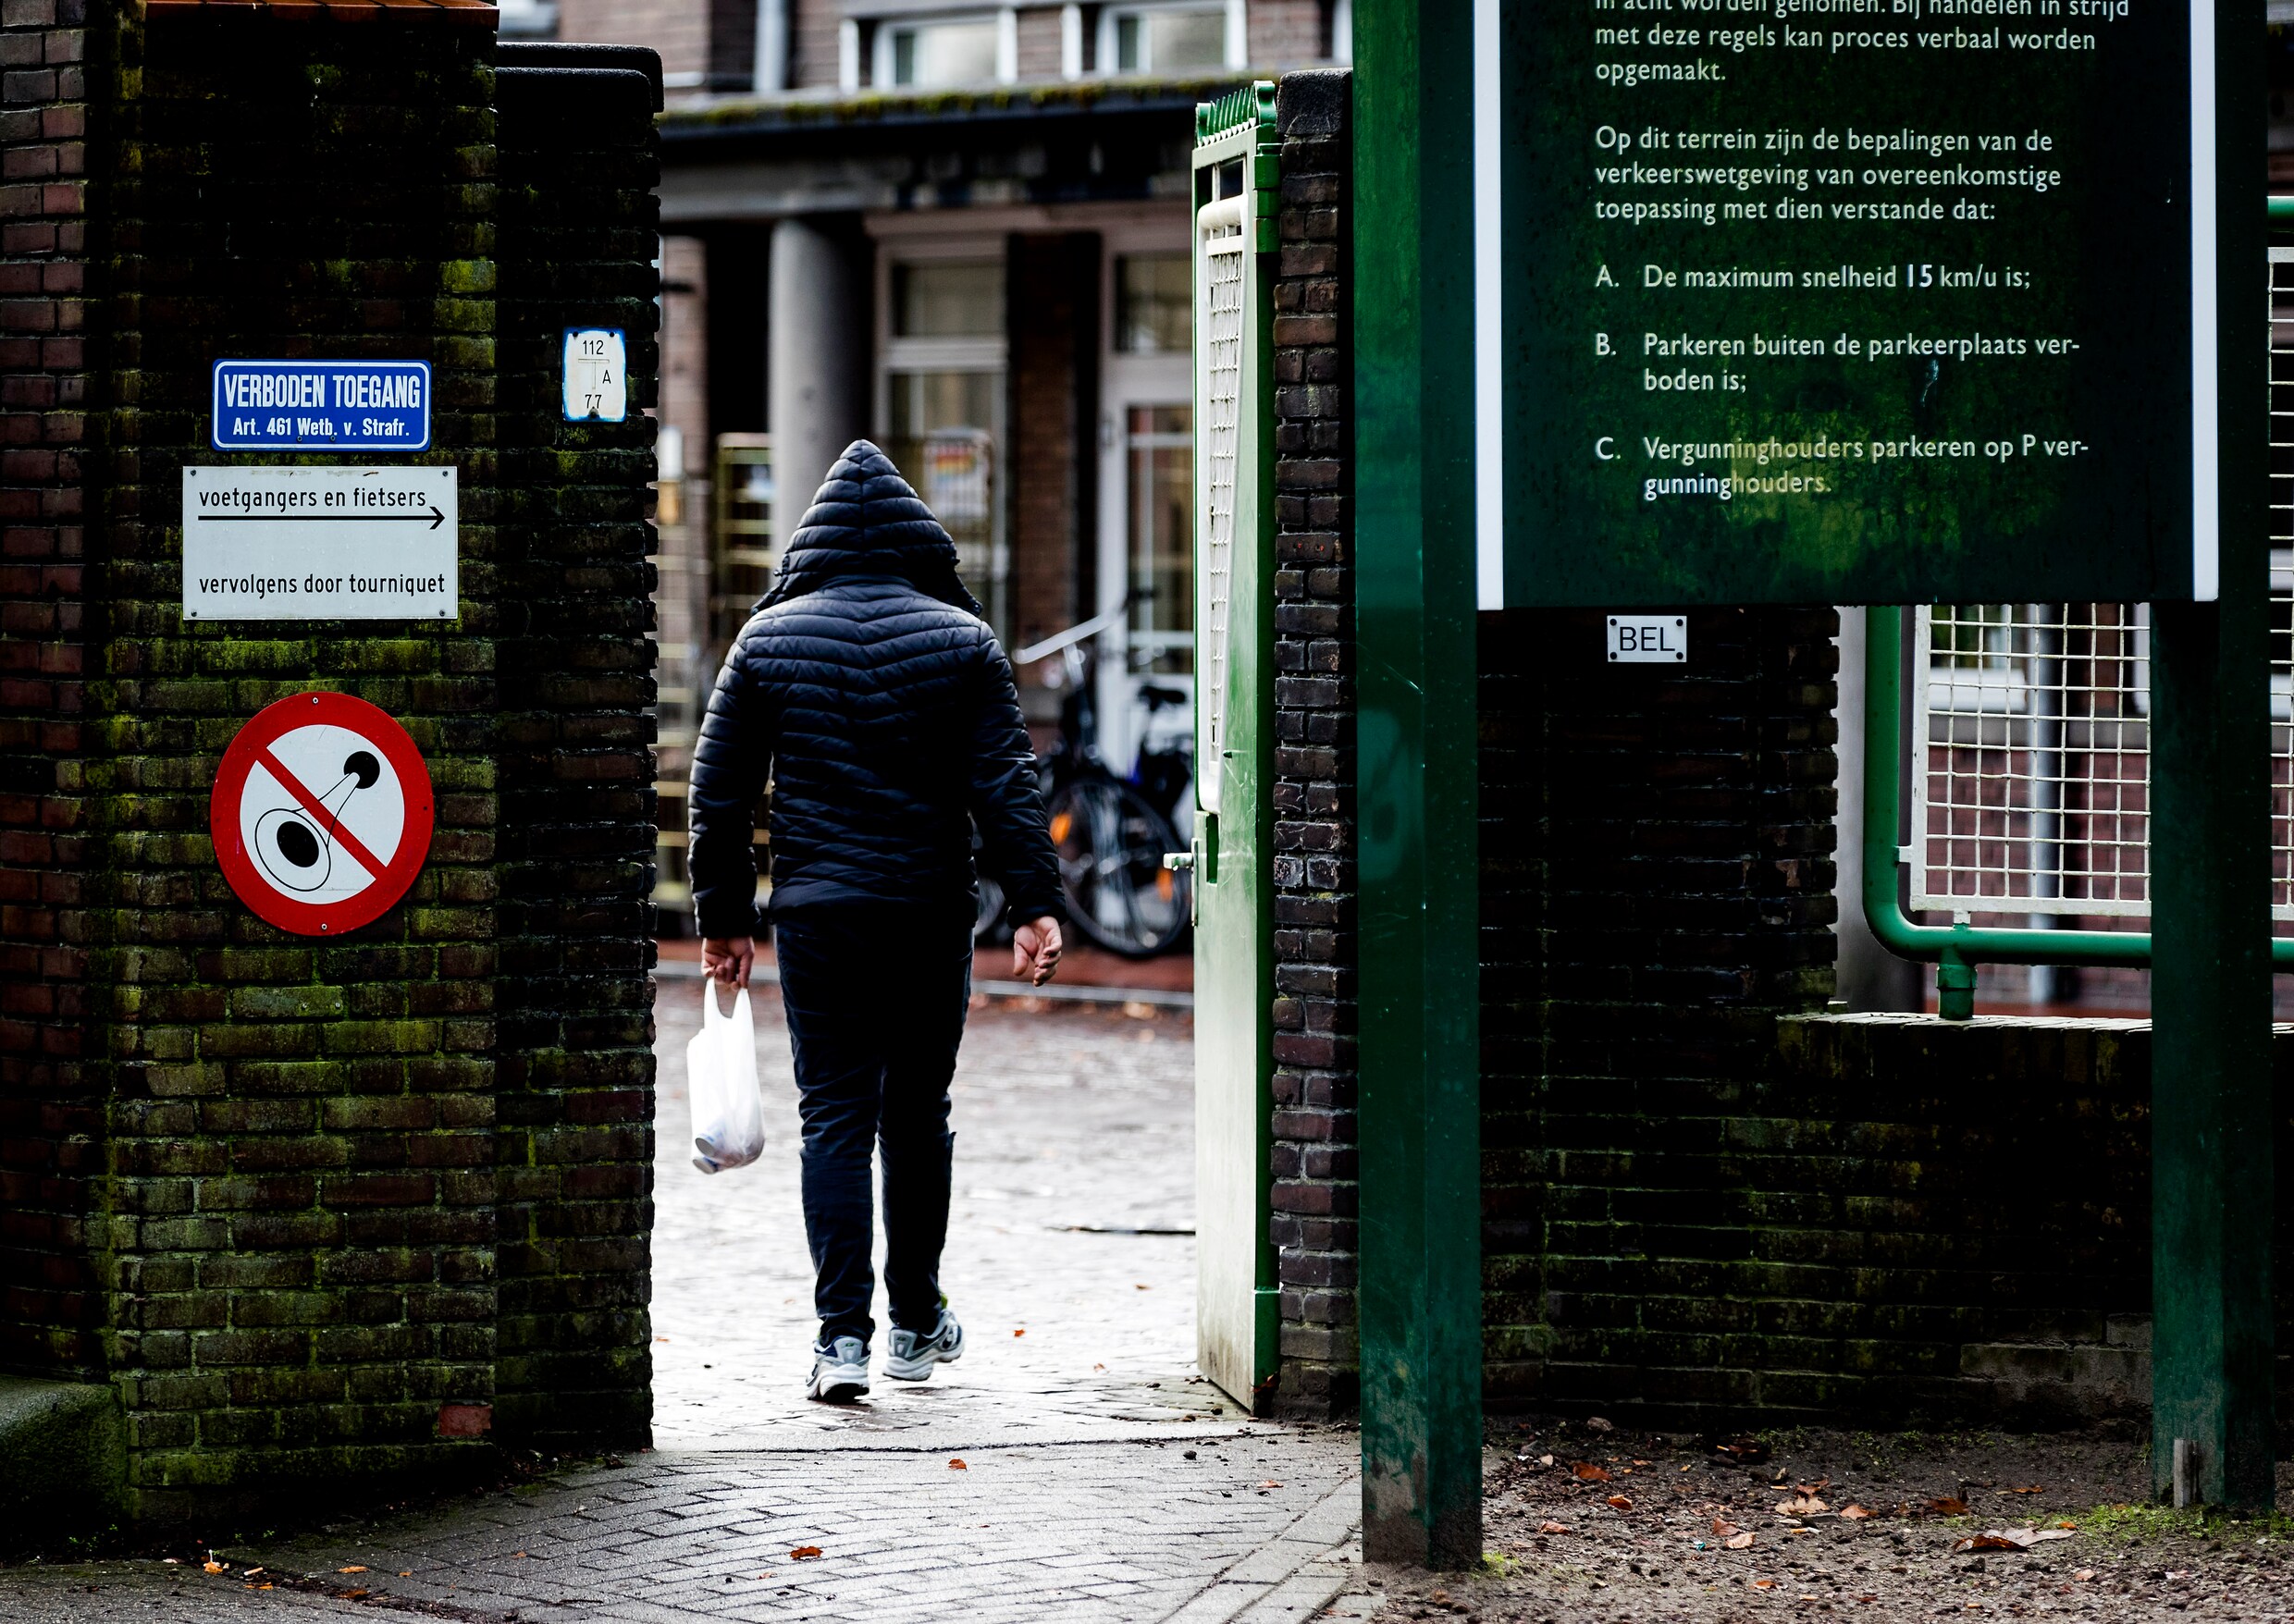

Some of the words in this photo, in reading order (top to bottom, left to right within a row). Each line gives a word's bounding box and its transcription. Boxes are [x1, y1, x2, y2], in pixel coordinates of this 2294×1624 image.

[1775, 0, 1886, 18] genomen.
[1596, 27, 1640, 45] met
[1647, 22, 1700, 46] deze
[1709, 23, 1776, 53] regels
[1784, 23, 1823, 47] kan
[1832, 30, 1909, 54] proces
[1917, 26, 1999, 49] verbaal
[2007, 27, 2095, 50] worden
[1596, 58, 1726, 87] opgemaakt.
[1595, 125, 1632, 154] Op
[1639, 126, 1671, 149] dit
[1677, 128, 1757, 150] terrein
[1764, 128, 1804, 156] zijn
[1812, 127, 1840, 150] de
[1848, 127, 1969, 157] bepalingen
[1978, 135, 2016, 151] van
[2026, 129, 2053, 152] de
[1595, 162, 1809, 191] verkeerswetgeving
[1816, 168, 1854, 185] van
[1862, 164, 2061, 192] overeenkomstige
[1595, 197, 1717, 226] toepassing
[1723, 201, 1769, 219] met
[1775, 196, 1823, 219] dien
[1831, 197, 1944, 220] verstande
[1952, 197, 1995, 220] dat:
[1595, 265, 1620, 288] A.
[1644, 265, 1677, 288] De
[1684, 265, 1794, 288] maximum
[1802, 265, 1897, 288] snelheid
[1907, 264, 1933, 288] 15
[1940, 263, 1997, 288] km/u
[2005, 265, 2030, 289] is;
[583, 339, 604, 355] 112
[1595, 332, 1617, 356] B.
[1644, 332, 1745, 356] Parkeren
[1753, 332, 1825, 356] buiten
[1832, 332, 1861, 355] de
[1868, 332, 2027, 362] parkeerplaats
[2034, 338, 2080, 355] ver-
[602, 369, 611, 385] A
[1644, 367, 1714, 391] boden
[1721, 368, 1746, 393] is;
[224, 374, 326, 408] VERBODEN
[332, 374, 422, 409] TOEGANG
[232, 417, 261, 436] Art.
[266, 417, 291, 436] 461
[297, 417, 338, 437] Wetb.
[343, 422, 357, 437] v.
[362, 417, 410, 437] Strafr.
[1595, 437, 1622, 461] C.
[1643, 436, 1864, 467] Vergunninghouders
[1871, 436, 1976, 464] parkeren
[1984, 441, 2014, 463] op
[2022, 434, 2037, 457] P
[2043, 440, 2089, 457] ver-
[1644, 470, 1832, 501] gunninghouders.
[199, 487, 317, 513] voetgangers
[324, 491, 346, 507] en
[352, 487, 426, 507] fietsers
[199, 573, 298, 600] vervolgens
[303, 573, 343, 594] door
[349, 573, 445, 597] tourniquet
[1619, 626, 1676, 653] BEL
